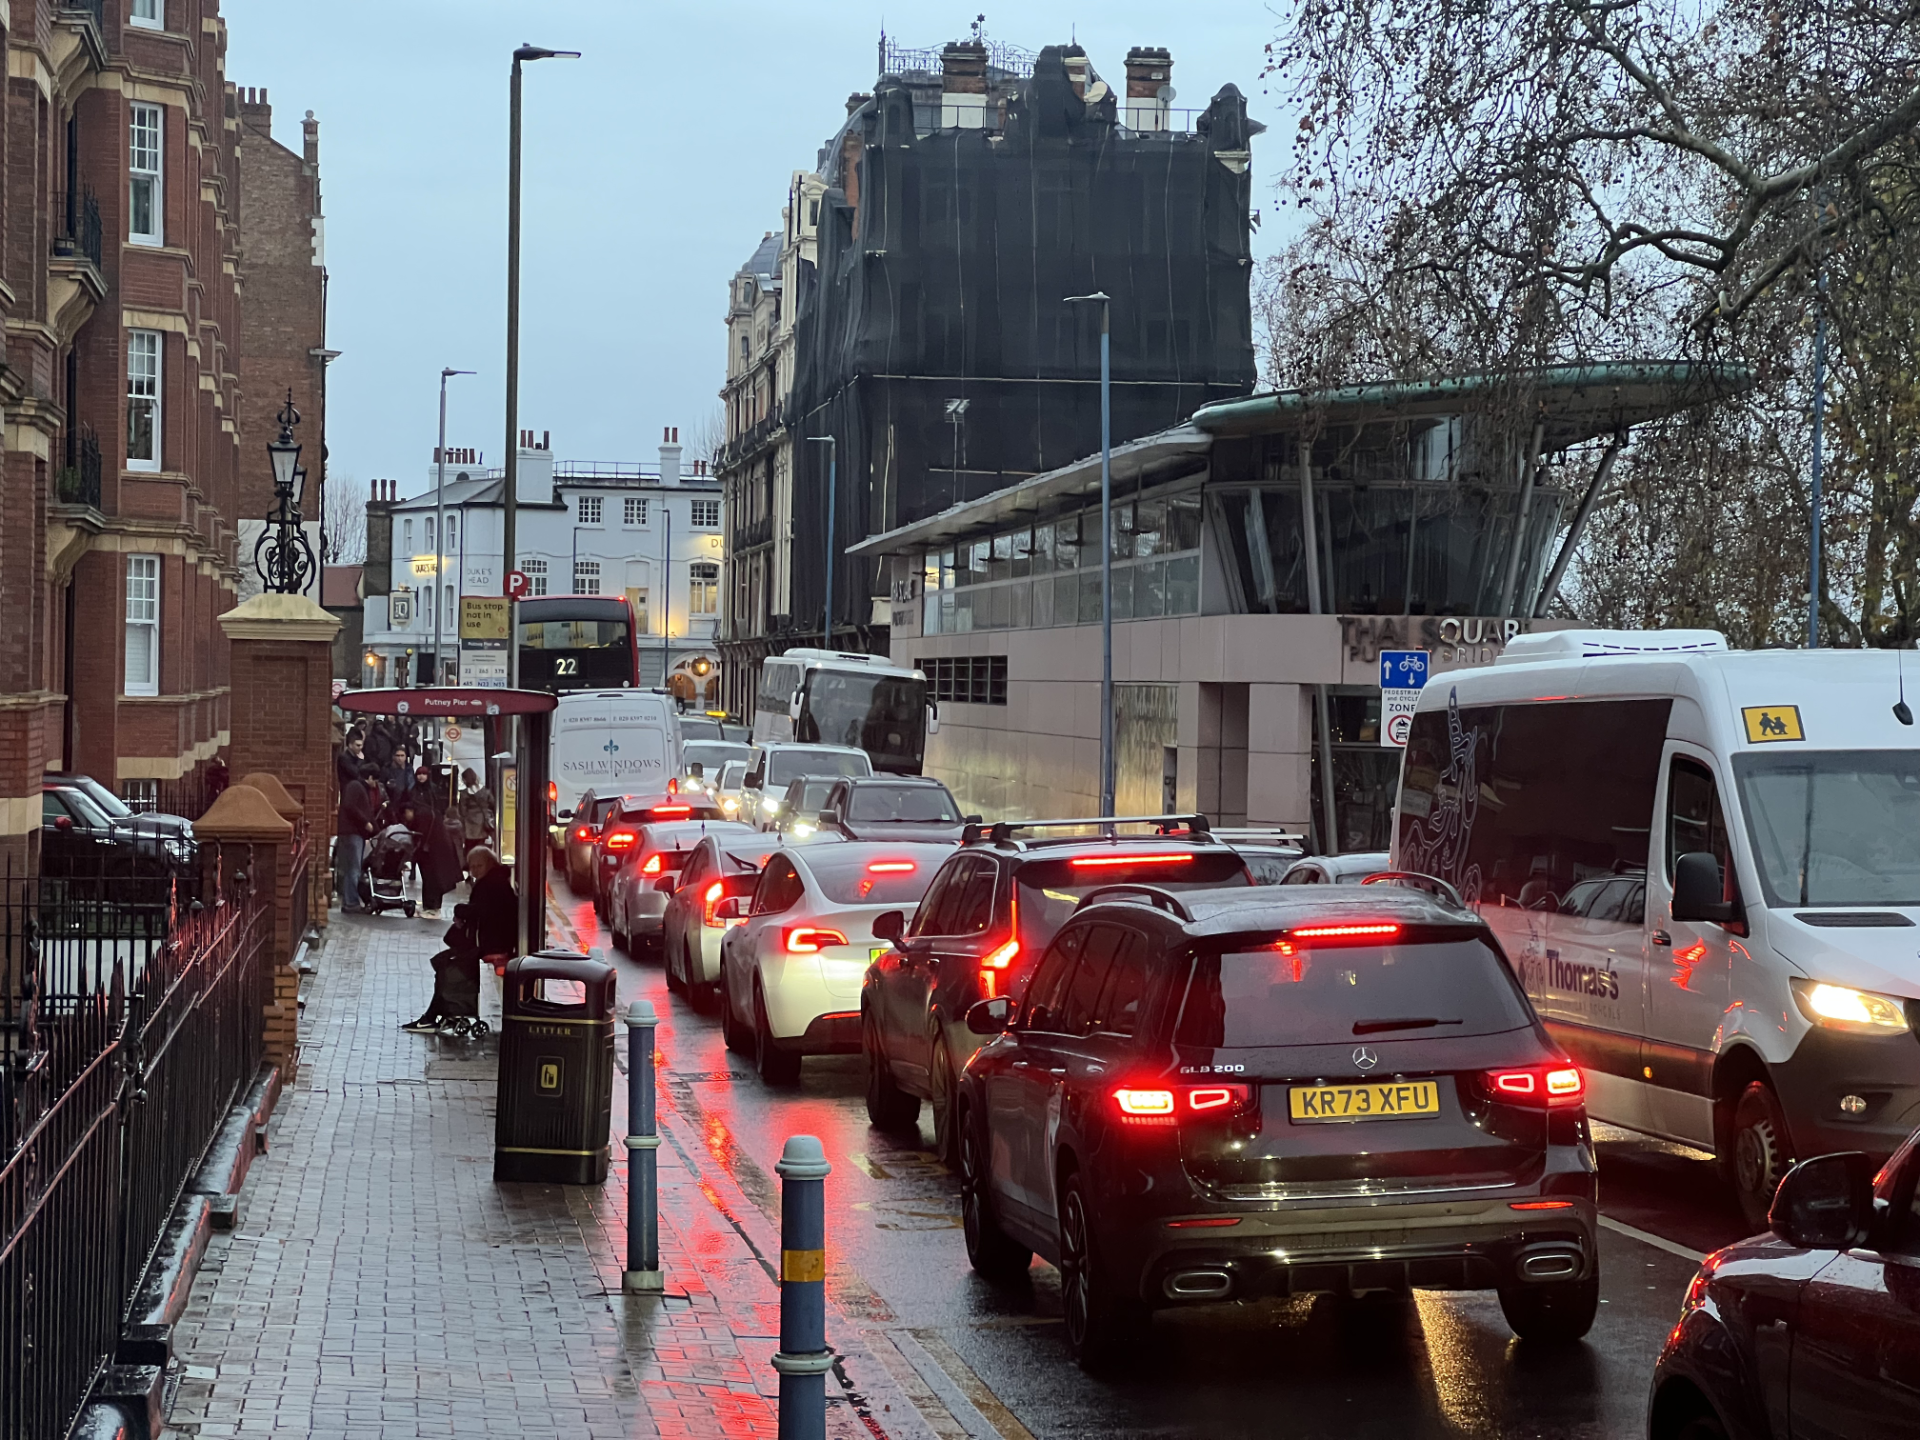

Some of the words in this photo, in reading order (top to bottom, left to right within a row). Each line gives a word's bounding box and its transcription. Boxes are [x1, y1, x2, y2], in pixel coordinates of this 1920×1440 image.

[509, 574, 523, 593] P
[466, 602, 482, 610] Bus
[484, 603, 504, 612] stop
[483, 611, 492, 619] in
[1337, 616, 1408, 645] THAI
[556, 658, 577, 675] 22
[424, 698, 451, 708] Putney
[453, 698, 468, 706] Pier
[1388, 703, 1416, 712] ZONE
[563, 761, 593, 771] SASH
[598, 758, 661, 769] WINDOWS
[1546, 949, 1619, 1001] Thomas's
[529, 1026, 571, 1036] LITTER
[1180, 1066, 1211, 1075] GLB
[1214, 1064, 1246, 1073] 200
[1302, 1088, 1372, 1116] KR73
[1378, 1086, 1430, 1113] XFU
